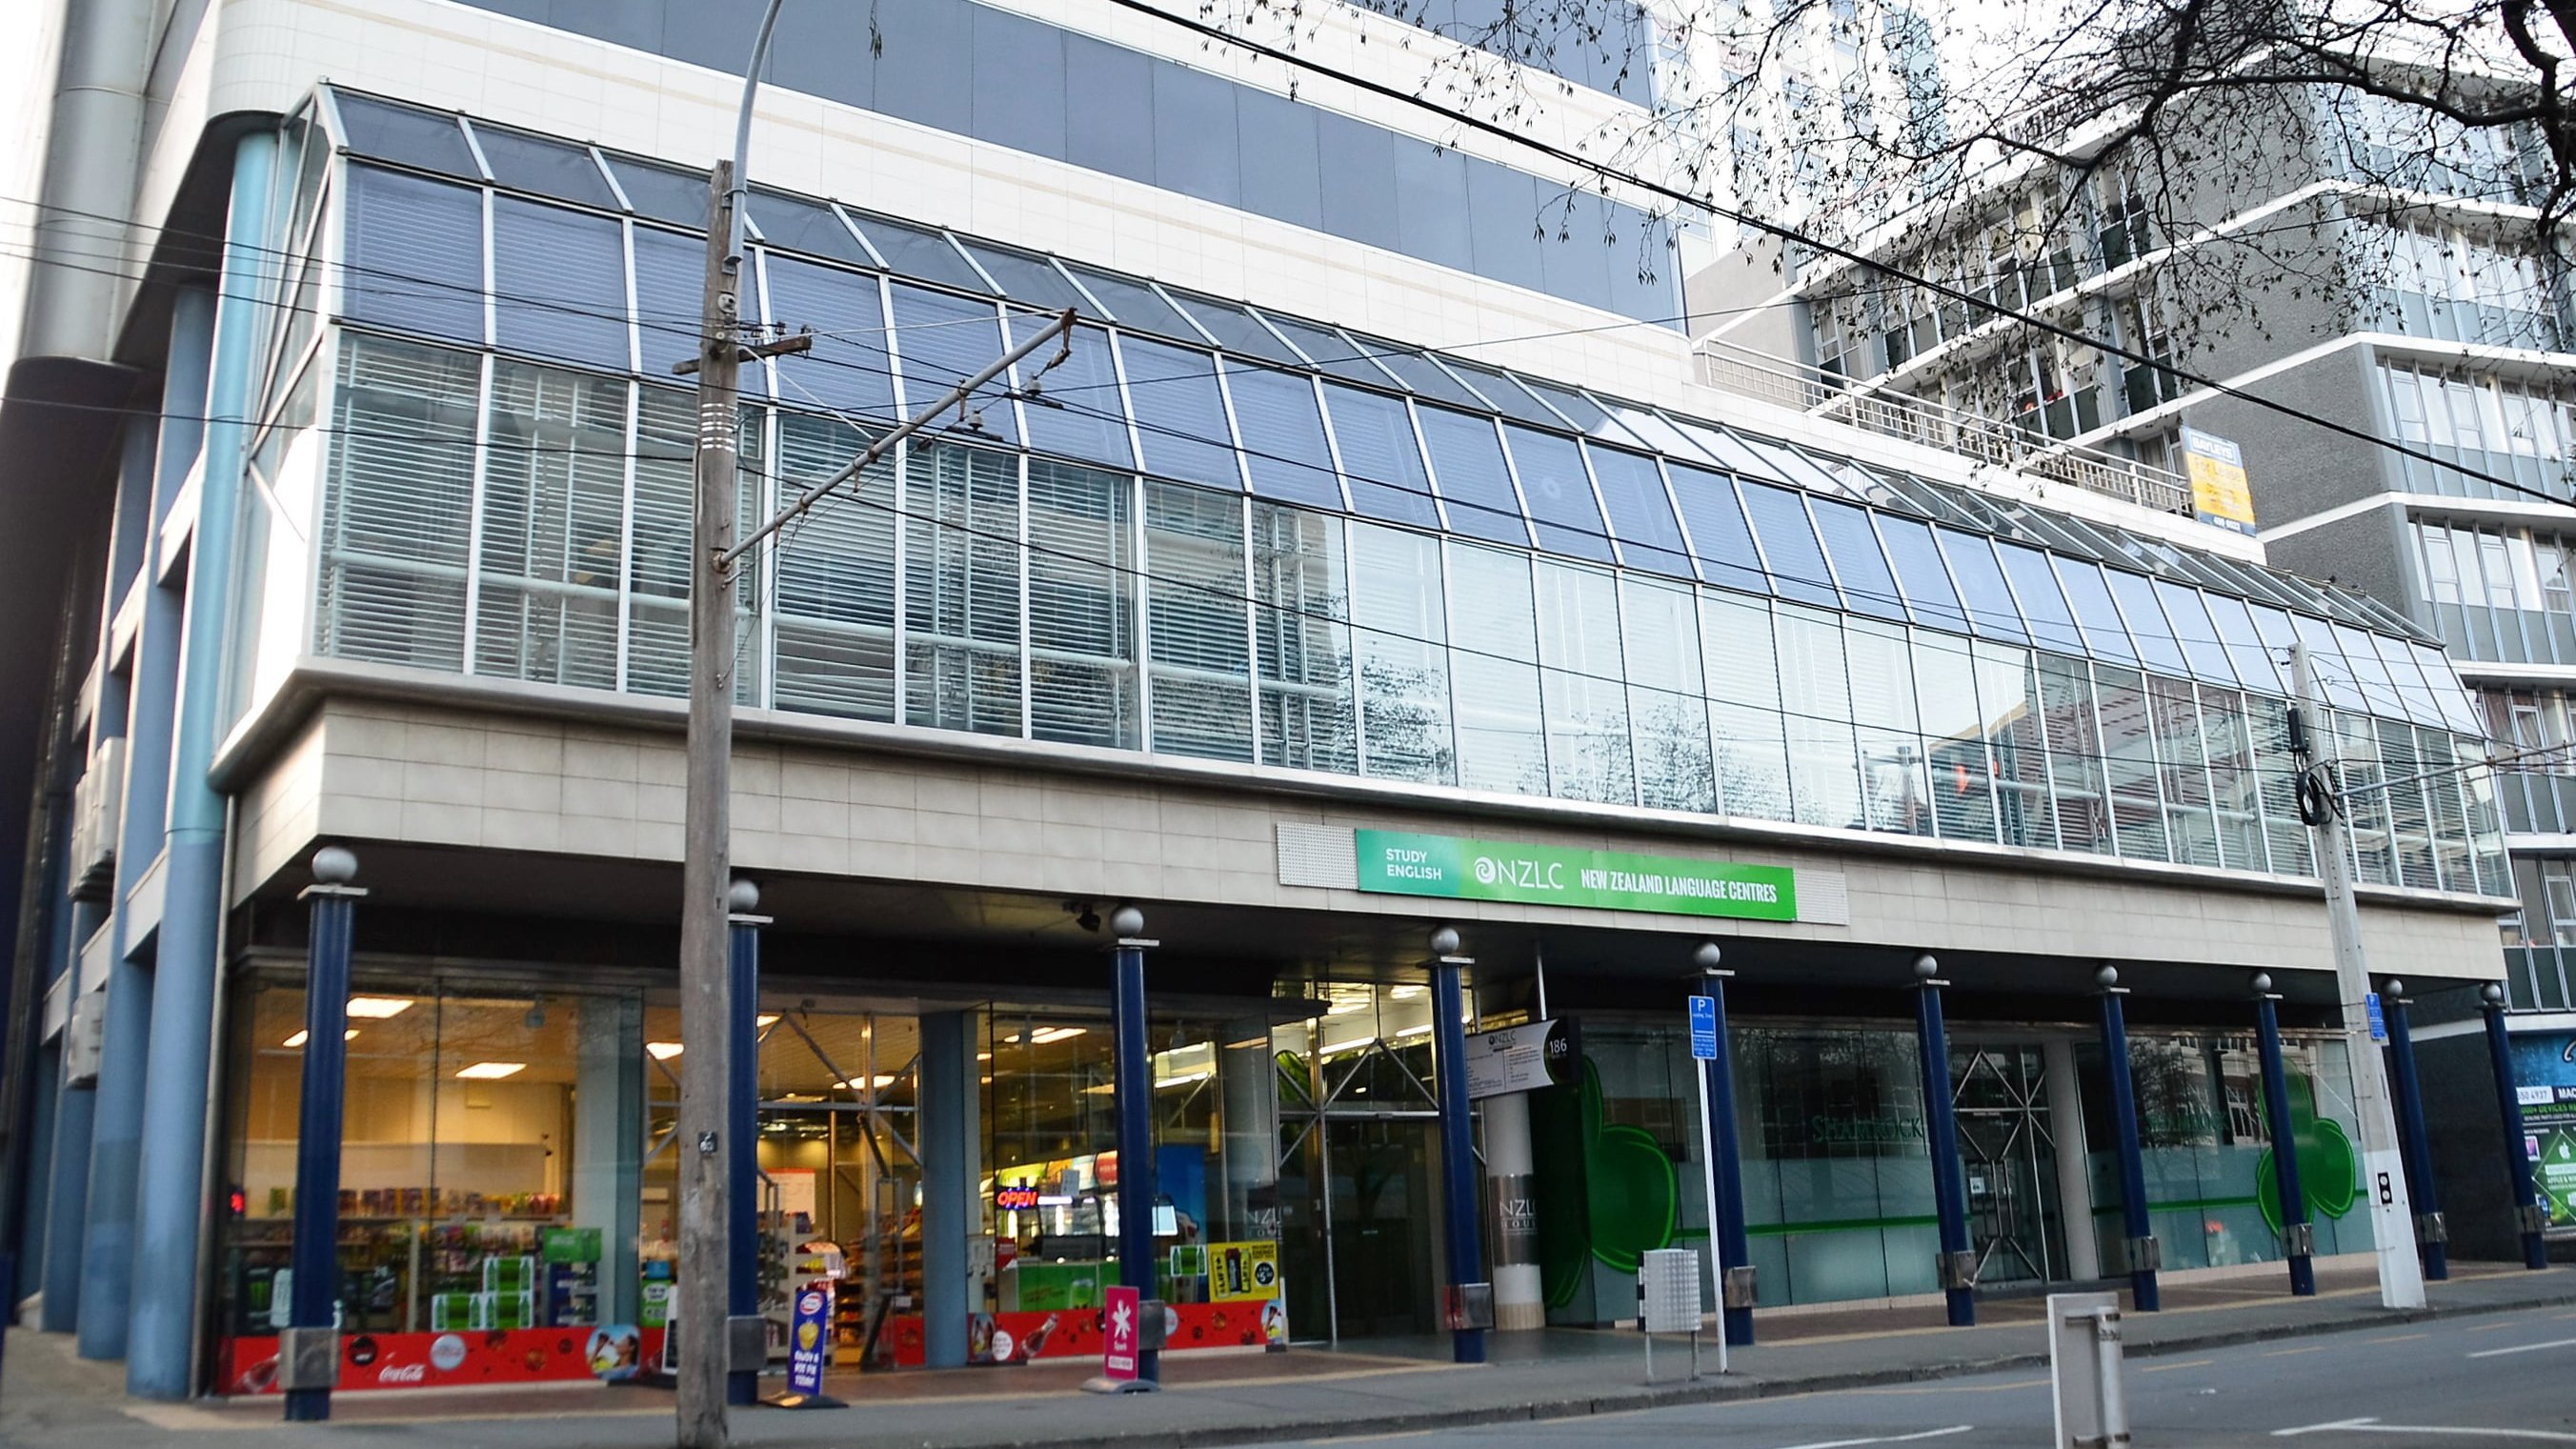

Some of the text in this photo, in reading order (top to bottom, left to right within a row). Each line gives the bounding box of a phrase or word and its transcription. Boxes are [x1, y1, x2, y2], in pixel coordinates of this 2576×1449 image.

[2192, 436, 2234, 459] BAYLEYS
[1386, 848, 1427, 863] STUDY
[1387, 864, 1442, 880] ENGLISH
[1498, 859, 1564, 890] NZLC
[1580, 869, 1777, 903] NEW ZEALAND LANGUAGE CENTRES
[1698, 999, 1706, 1012] P
[1549, 1037, 1568, 1055] 186
[997, 1191, 1037, 1206] OPEN
